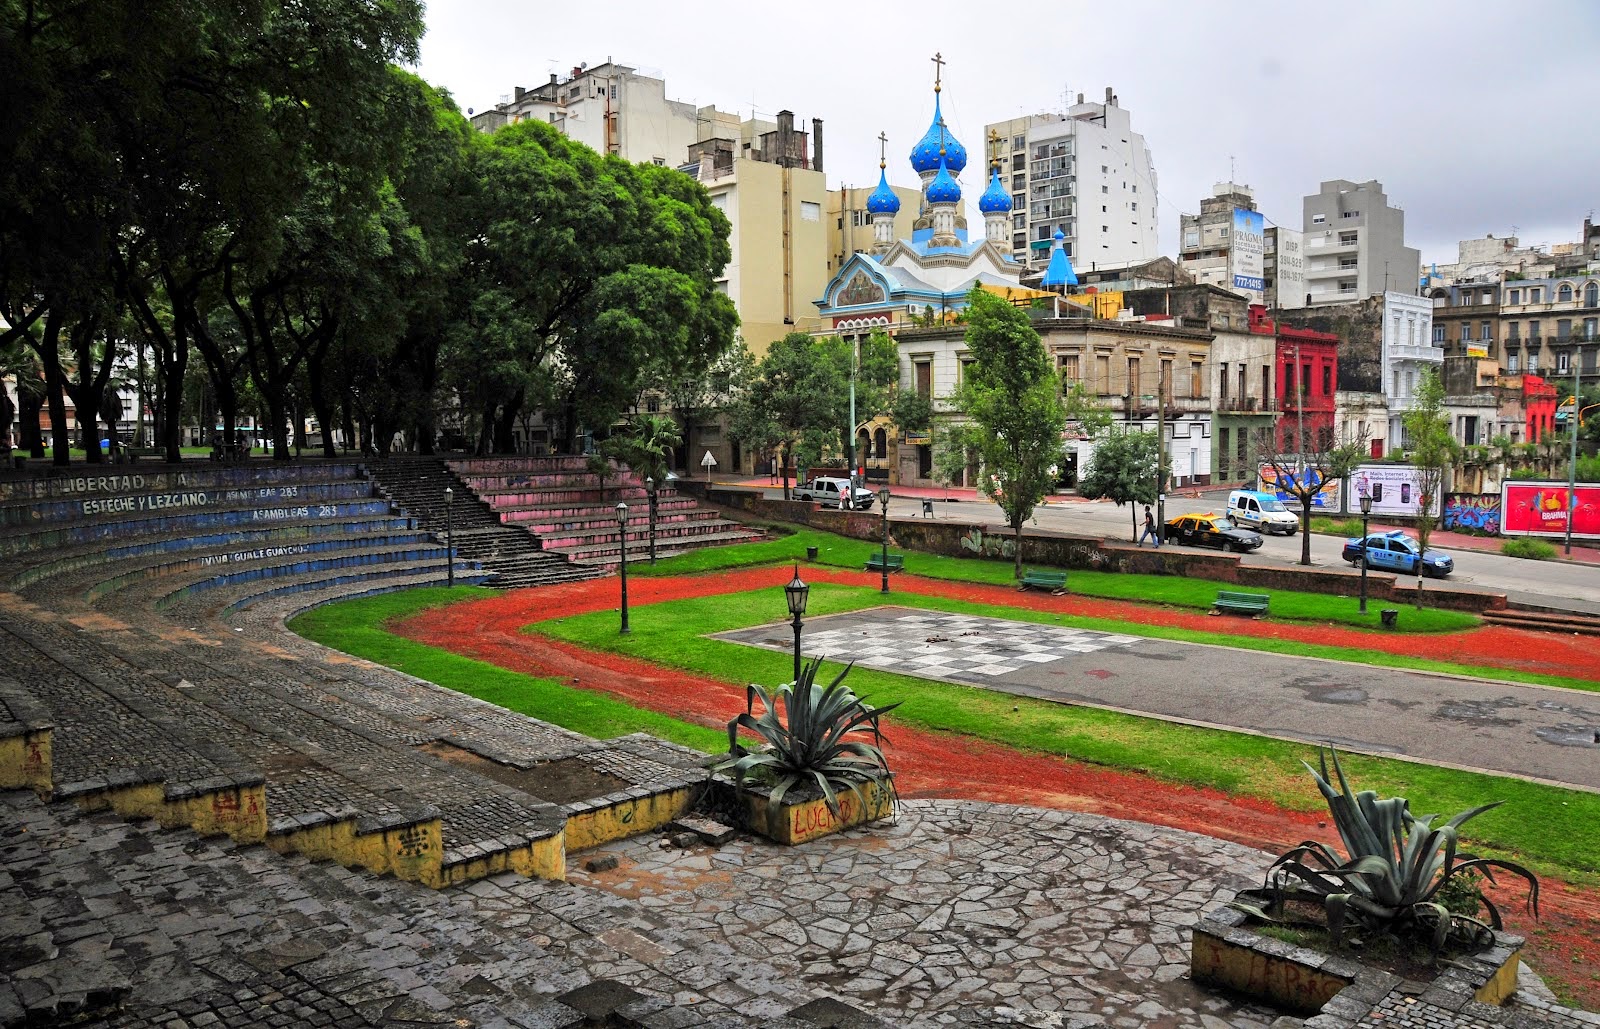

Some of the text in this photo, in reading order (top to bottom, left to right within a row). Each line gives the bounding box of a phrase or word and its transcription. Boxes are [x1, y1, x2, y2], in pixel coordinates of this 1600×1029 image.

[1235, 230, 1263, 245] PRAGMA
[1236, 276, 1262, 289] 777-1415
[279, 486, 298, 497] 283
[83, 496, 136, 515] ESTECHE
[138, 496, 145, 511] Y
[252, 505, 337, 520] ASAMBLEAS 283
[1541, 510, 1568, 520] BRAHMA
[1374, 551, 1387, 559] 911
